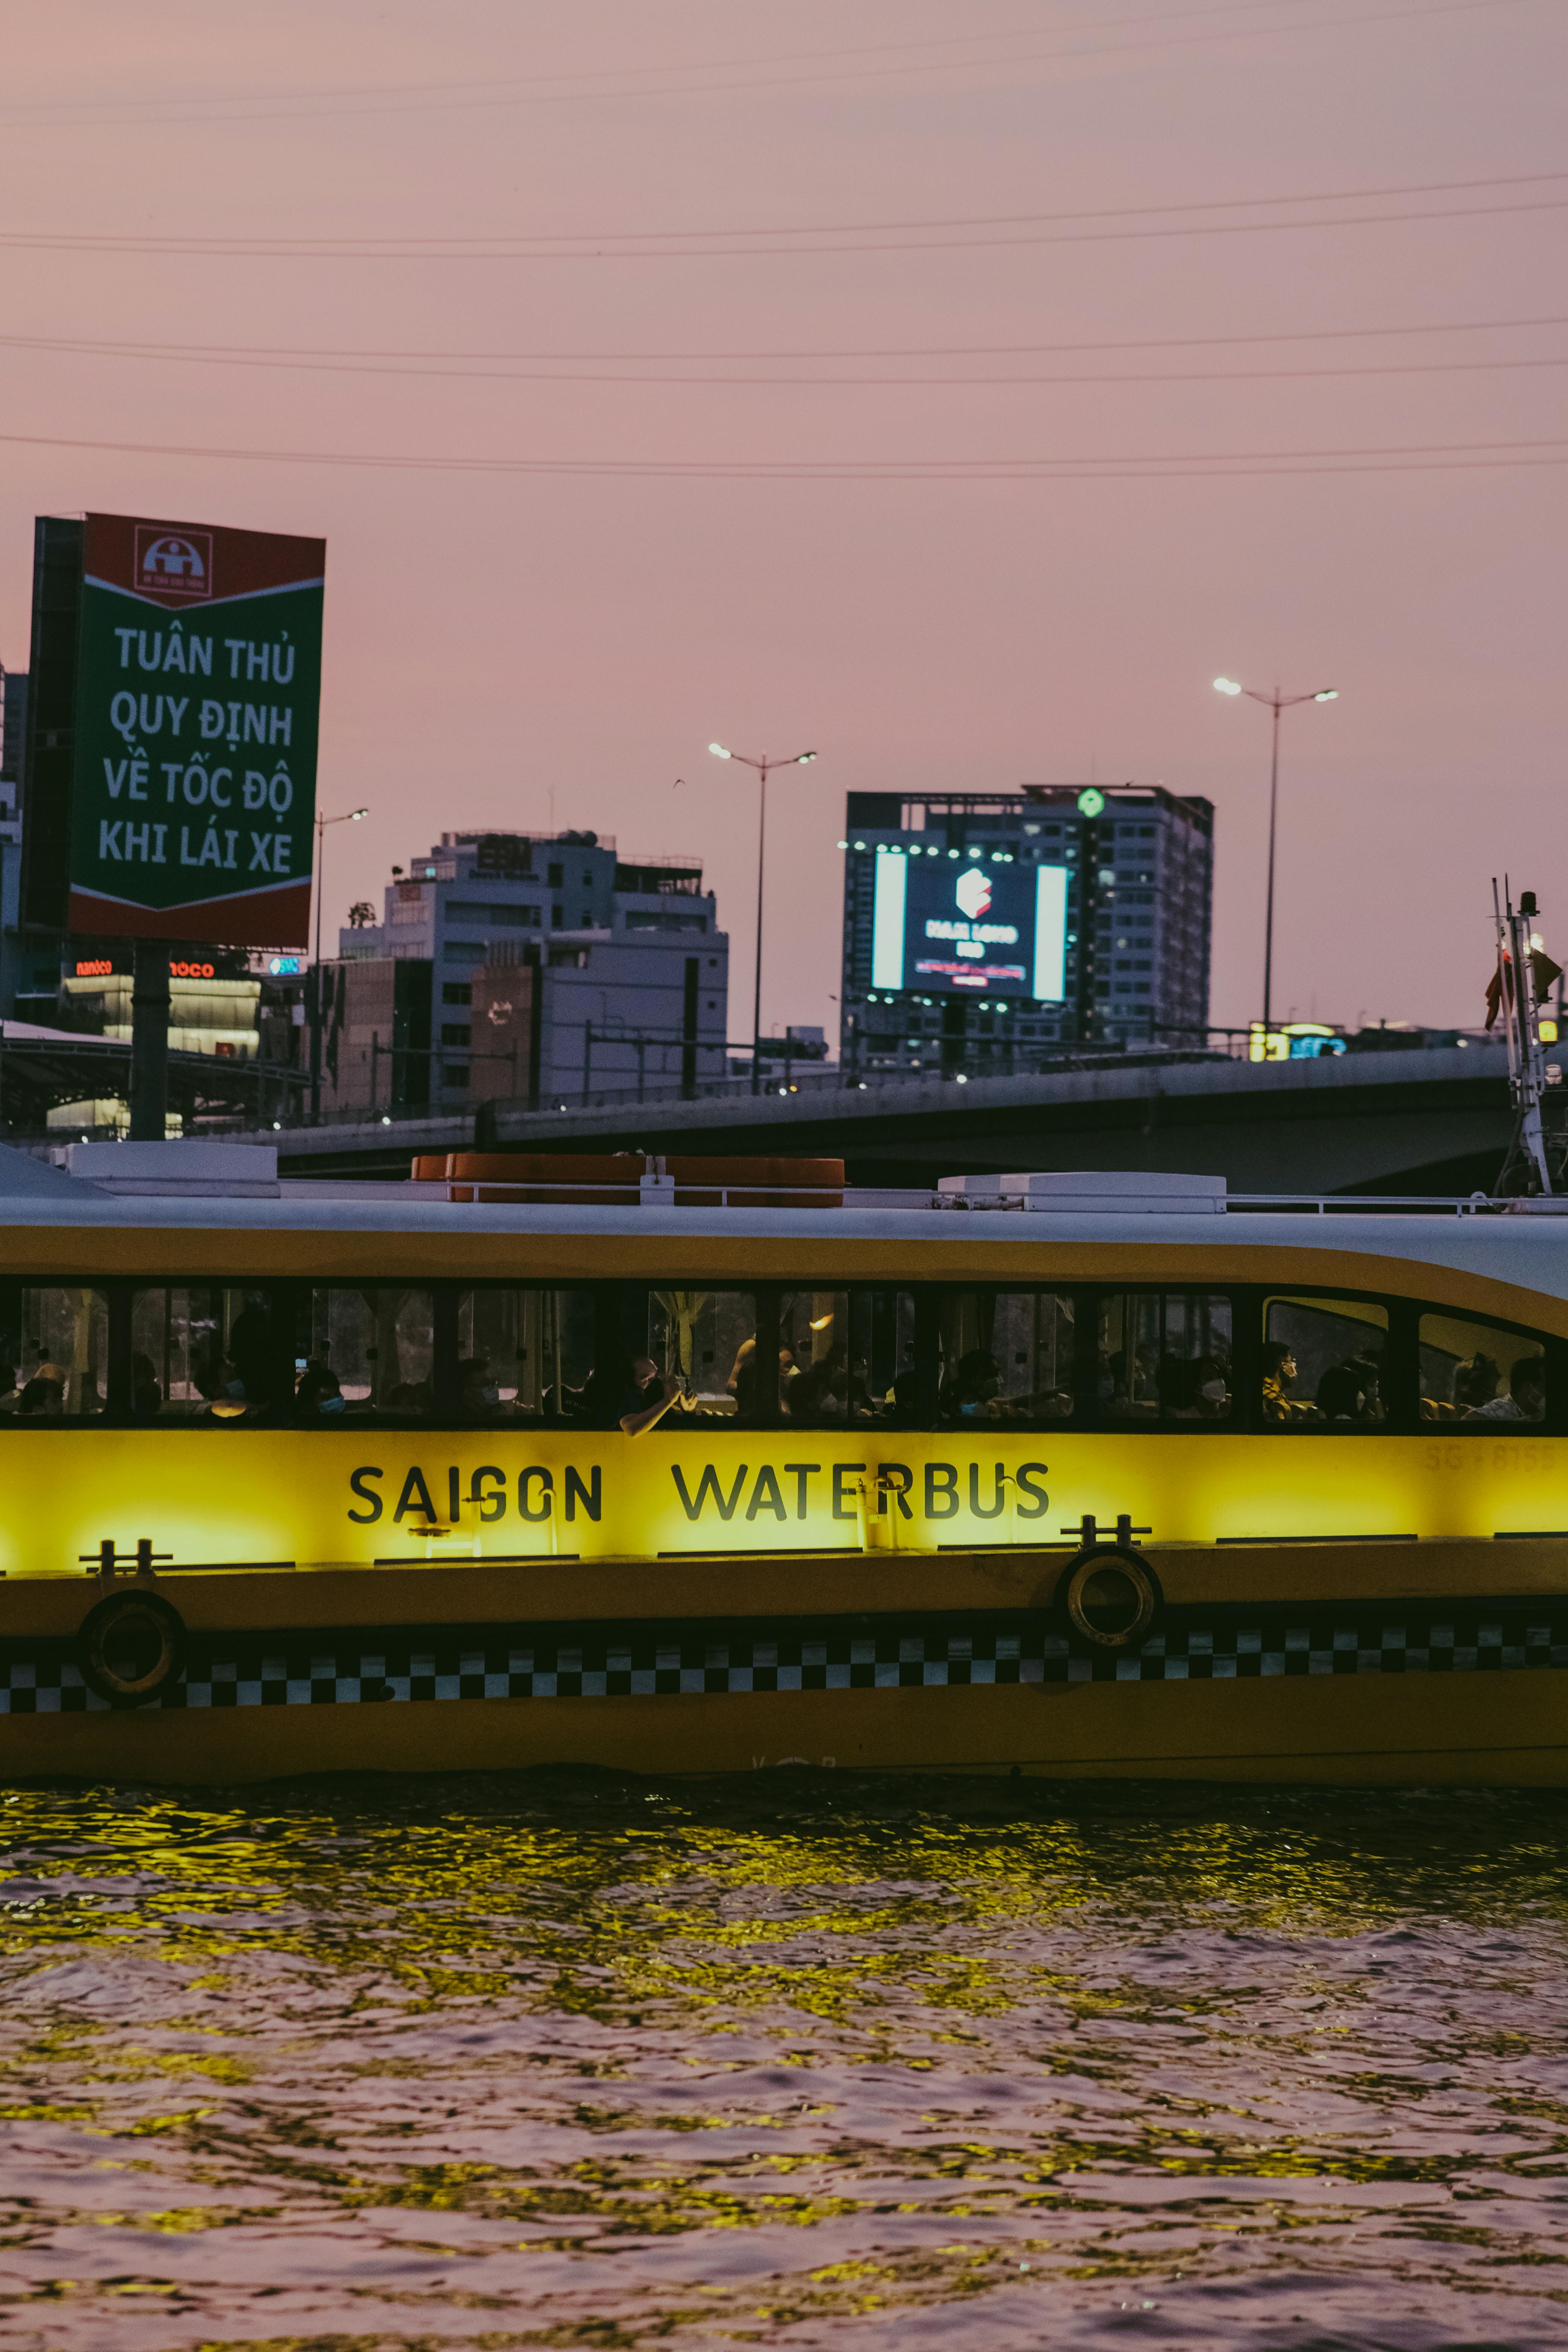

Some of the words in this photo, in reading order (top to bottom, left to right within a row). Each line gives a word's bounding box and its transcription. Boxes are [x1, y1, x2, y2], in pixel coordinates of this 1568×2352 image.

[115, 620, 212, 675] TUÂN
[225, 630, 295, 683] THỦ
[110, 692, 188, 742] QUY
[199, 700, 292, 751] ĐỊNH
[103, 746, 149, 800] VỀ
[161, 752, 233, 807] TỐC
[242, 760, 293, 822] ĐỘ
[99, 820, 167, 862] KHI
[181, 814, 239, 870] LÁI
[249, 833, 292, 873] XE
[348, 1465, 602, 1524] SAIGON
[671, 1462, 1049, 1520] WATERBUS
